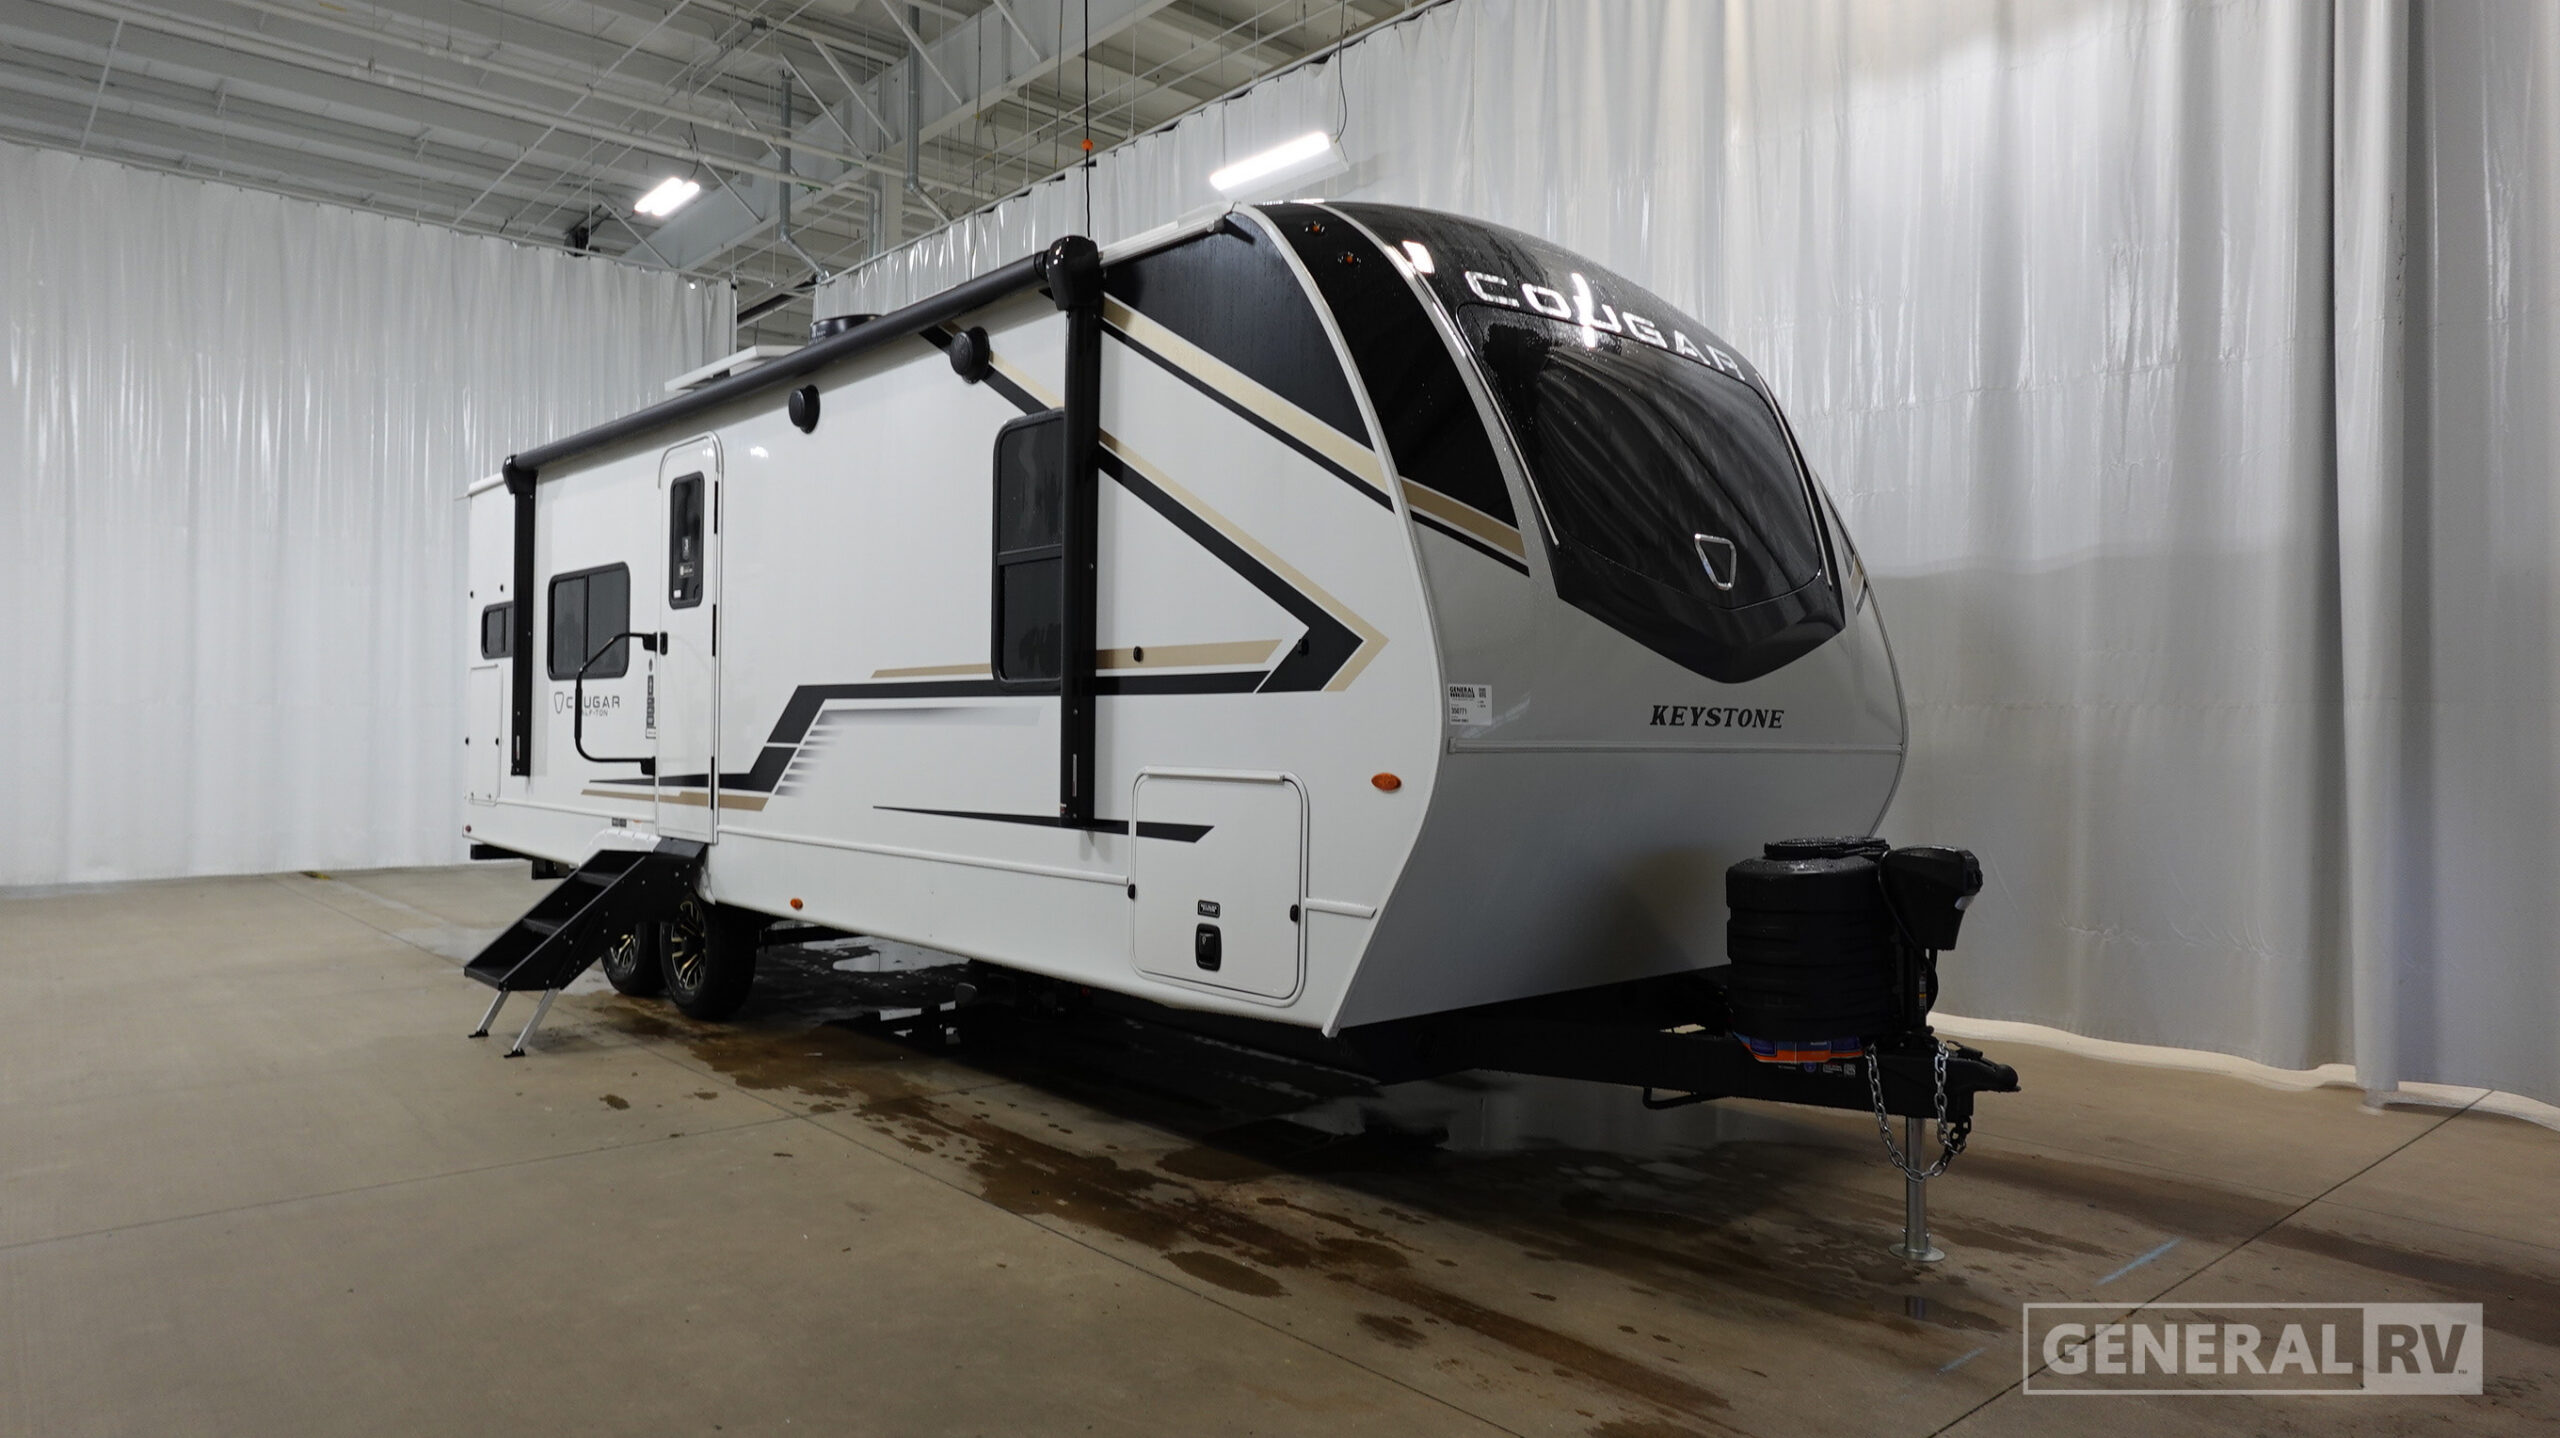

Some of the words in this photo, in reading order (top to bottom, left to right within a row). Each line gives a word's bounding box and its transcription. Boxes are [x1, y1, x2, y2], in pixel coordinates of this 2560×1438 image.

[1465, 271, 1746, 381] COUGAR
[566, 696, 620, 709] CUGAR
[1650, 704, 1785, 728] KEYSTONE
